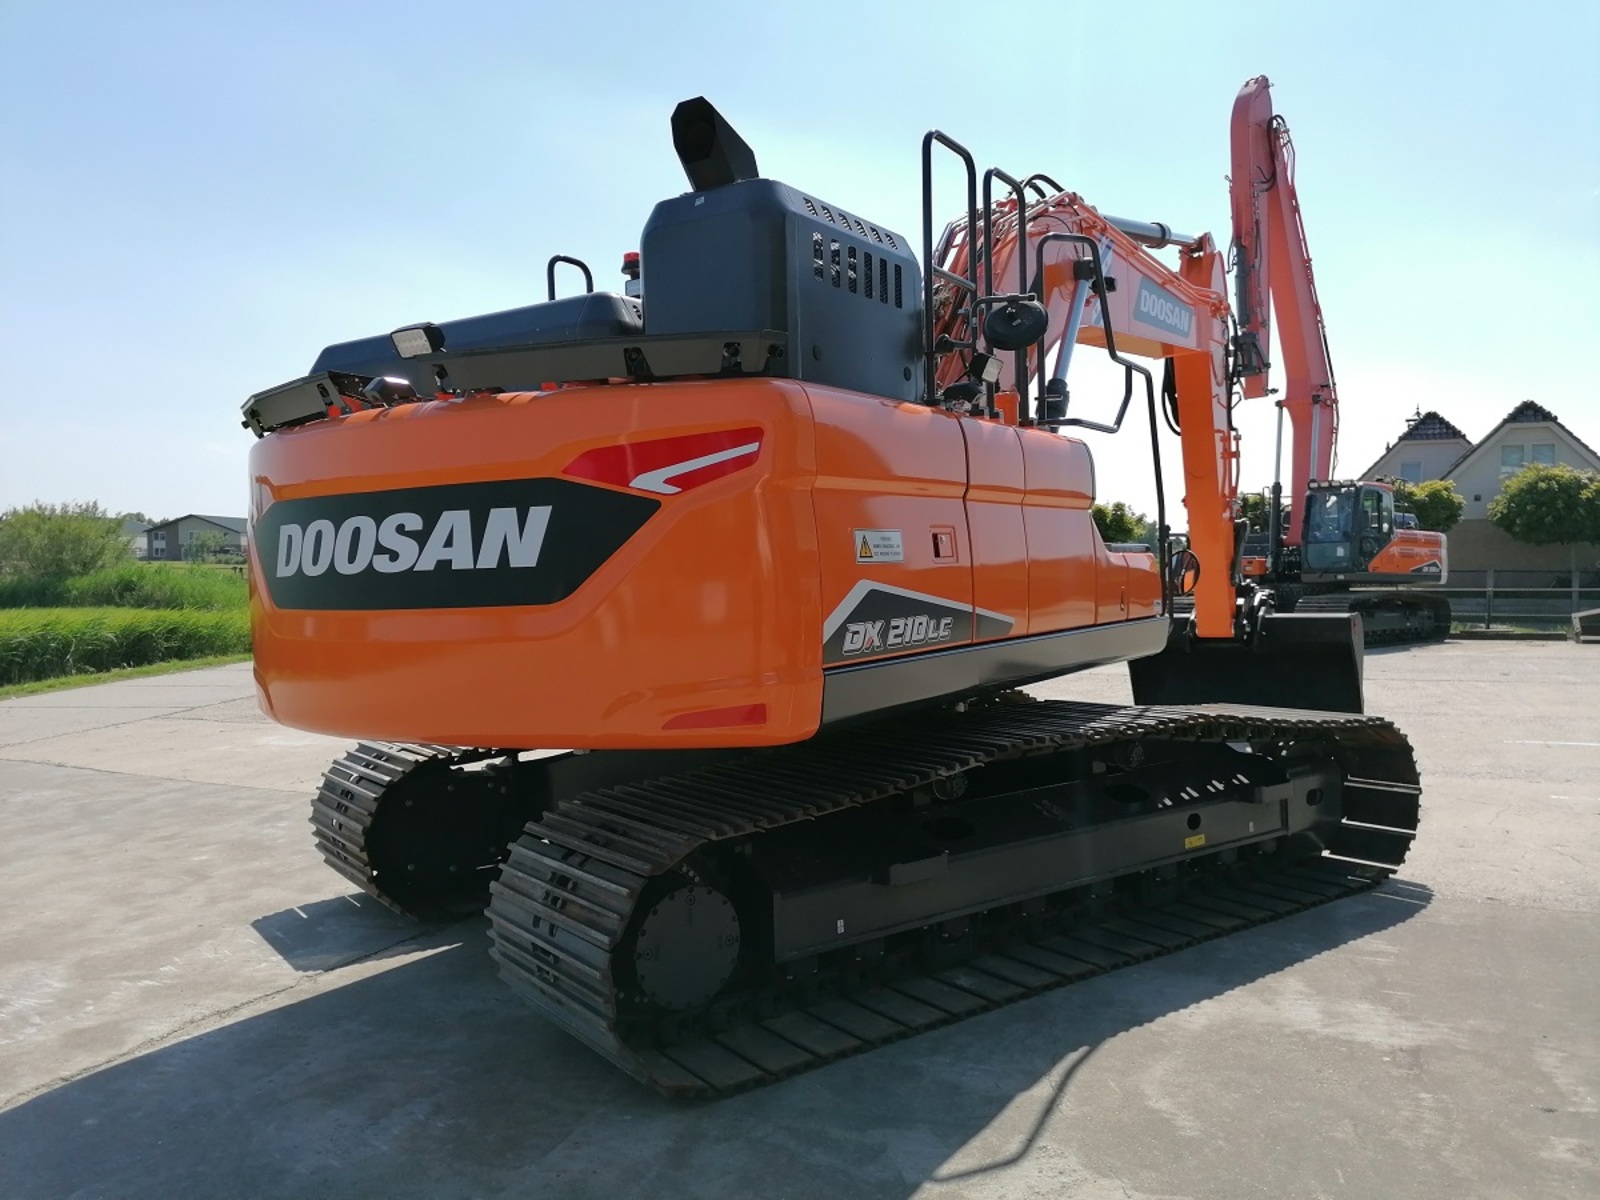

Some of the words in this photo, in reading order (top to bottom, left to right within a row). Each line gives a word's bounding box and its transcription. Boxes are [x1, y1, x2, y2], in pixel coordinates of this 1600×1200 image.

[1140, 289, 1189, 332] DOOSAN
[276, 505, 553, 578] DOOSAN
[843, 619, 885, 655] DX
